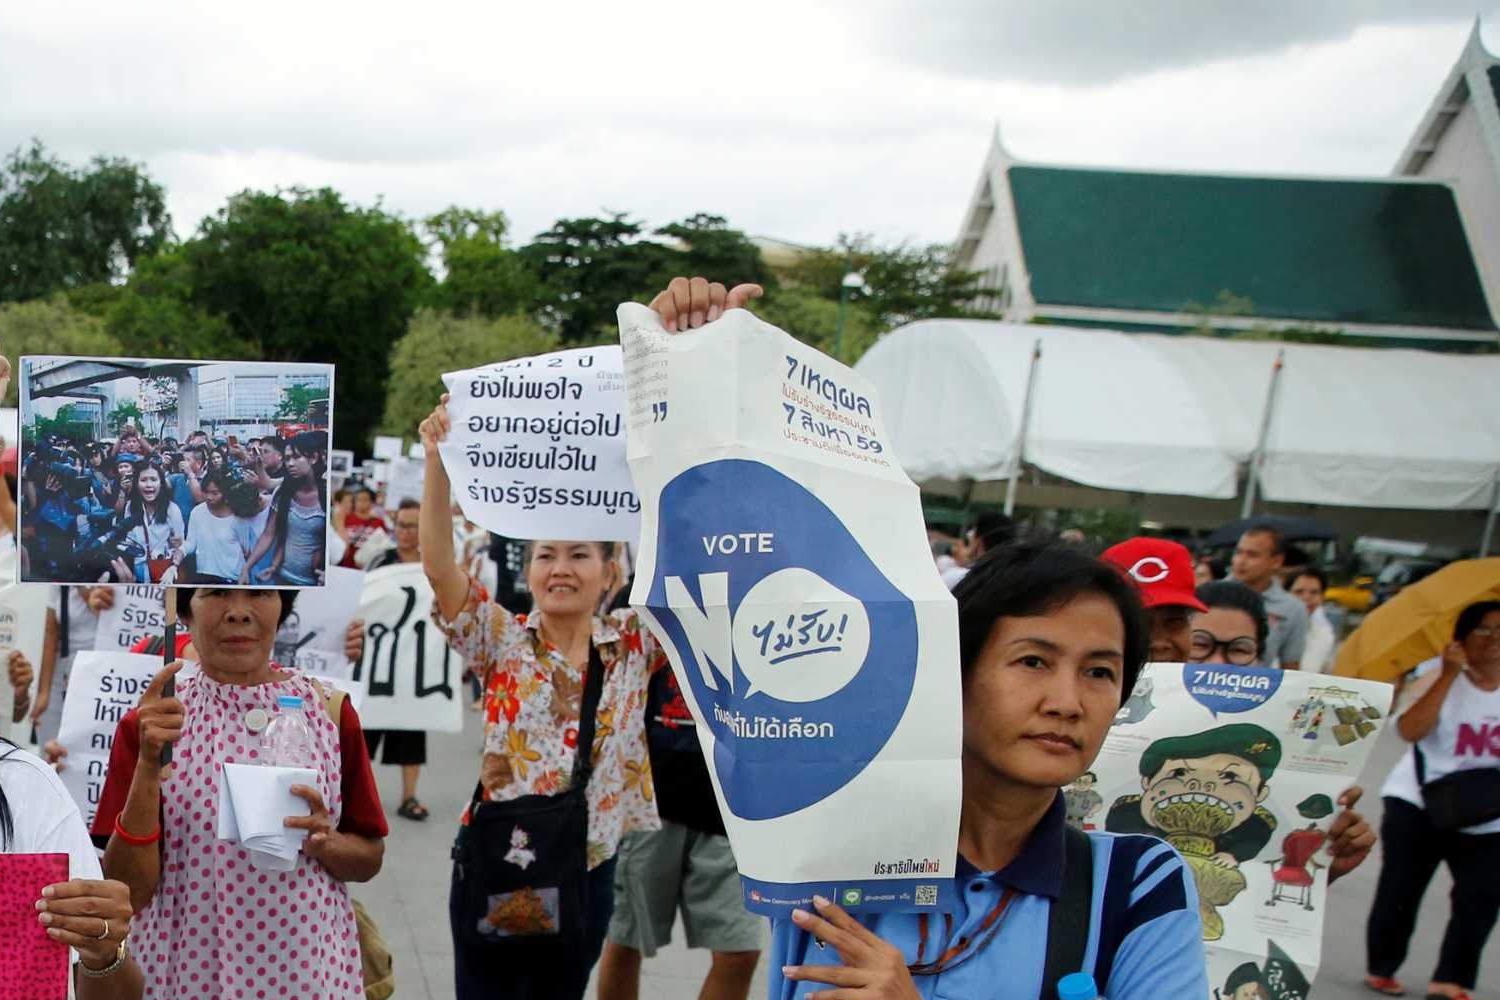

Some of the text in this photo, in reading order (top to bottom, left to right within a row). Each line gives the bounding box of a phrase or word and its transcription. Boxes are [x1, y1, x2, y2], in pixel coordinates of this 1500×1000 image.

[469, 374, 583, 401] ยังไม่พอใจ
[468, 411, 621, 442] อยากอยู่ต่อไป
[783, 402, 795, 425] 7
[857, 435, 883, 454] 59
[466, 443, 597, 472] จึงเขียนไว้ใน
[467, 478, 642, 515] ร่างรัฐธรรมนูญ
[702, 532, 775, 557] VOTE
[752, 608, 849, 657] ไม่รับ!
